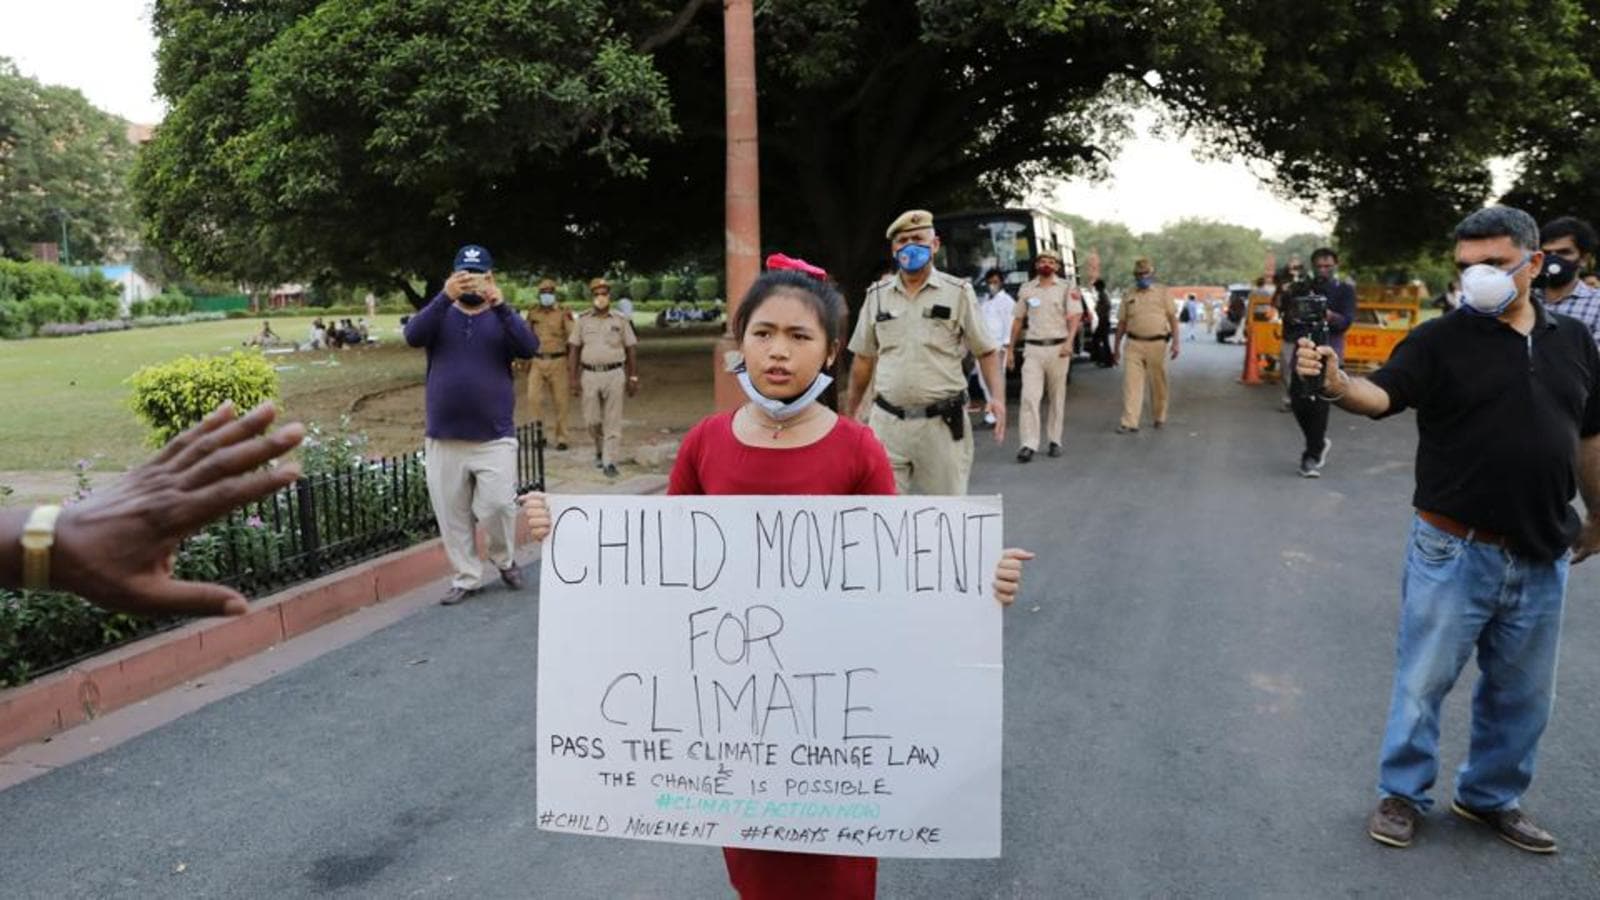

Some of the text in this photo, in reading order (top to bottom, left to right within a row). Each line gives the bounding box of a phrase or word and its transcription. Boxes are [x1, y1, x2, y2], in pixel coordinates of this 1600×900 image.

[551, 507, 1000, 596] CHILD MOVEMENT
[689, 604, 784, 669] FOR
[600, 667, 893, 740] CLIMATE
[550, 734, 940, 769] PASS THE CLIMATE CHANGE LAW
[599, 771, 893, 797] THE CHANGE IS POSSIBLE
[539, 810, 609, 833] #CHILD
[623, 816, 720, 840] MOVEMENT
[740, 825, 830, 844] #FRIDAYS
